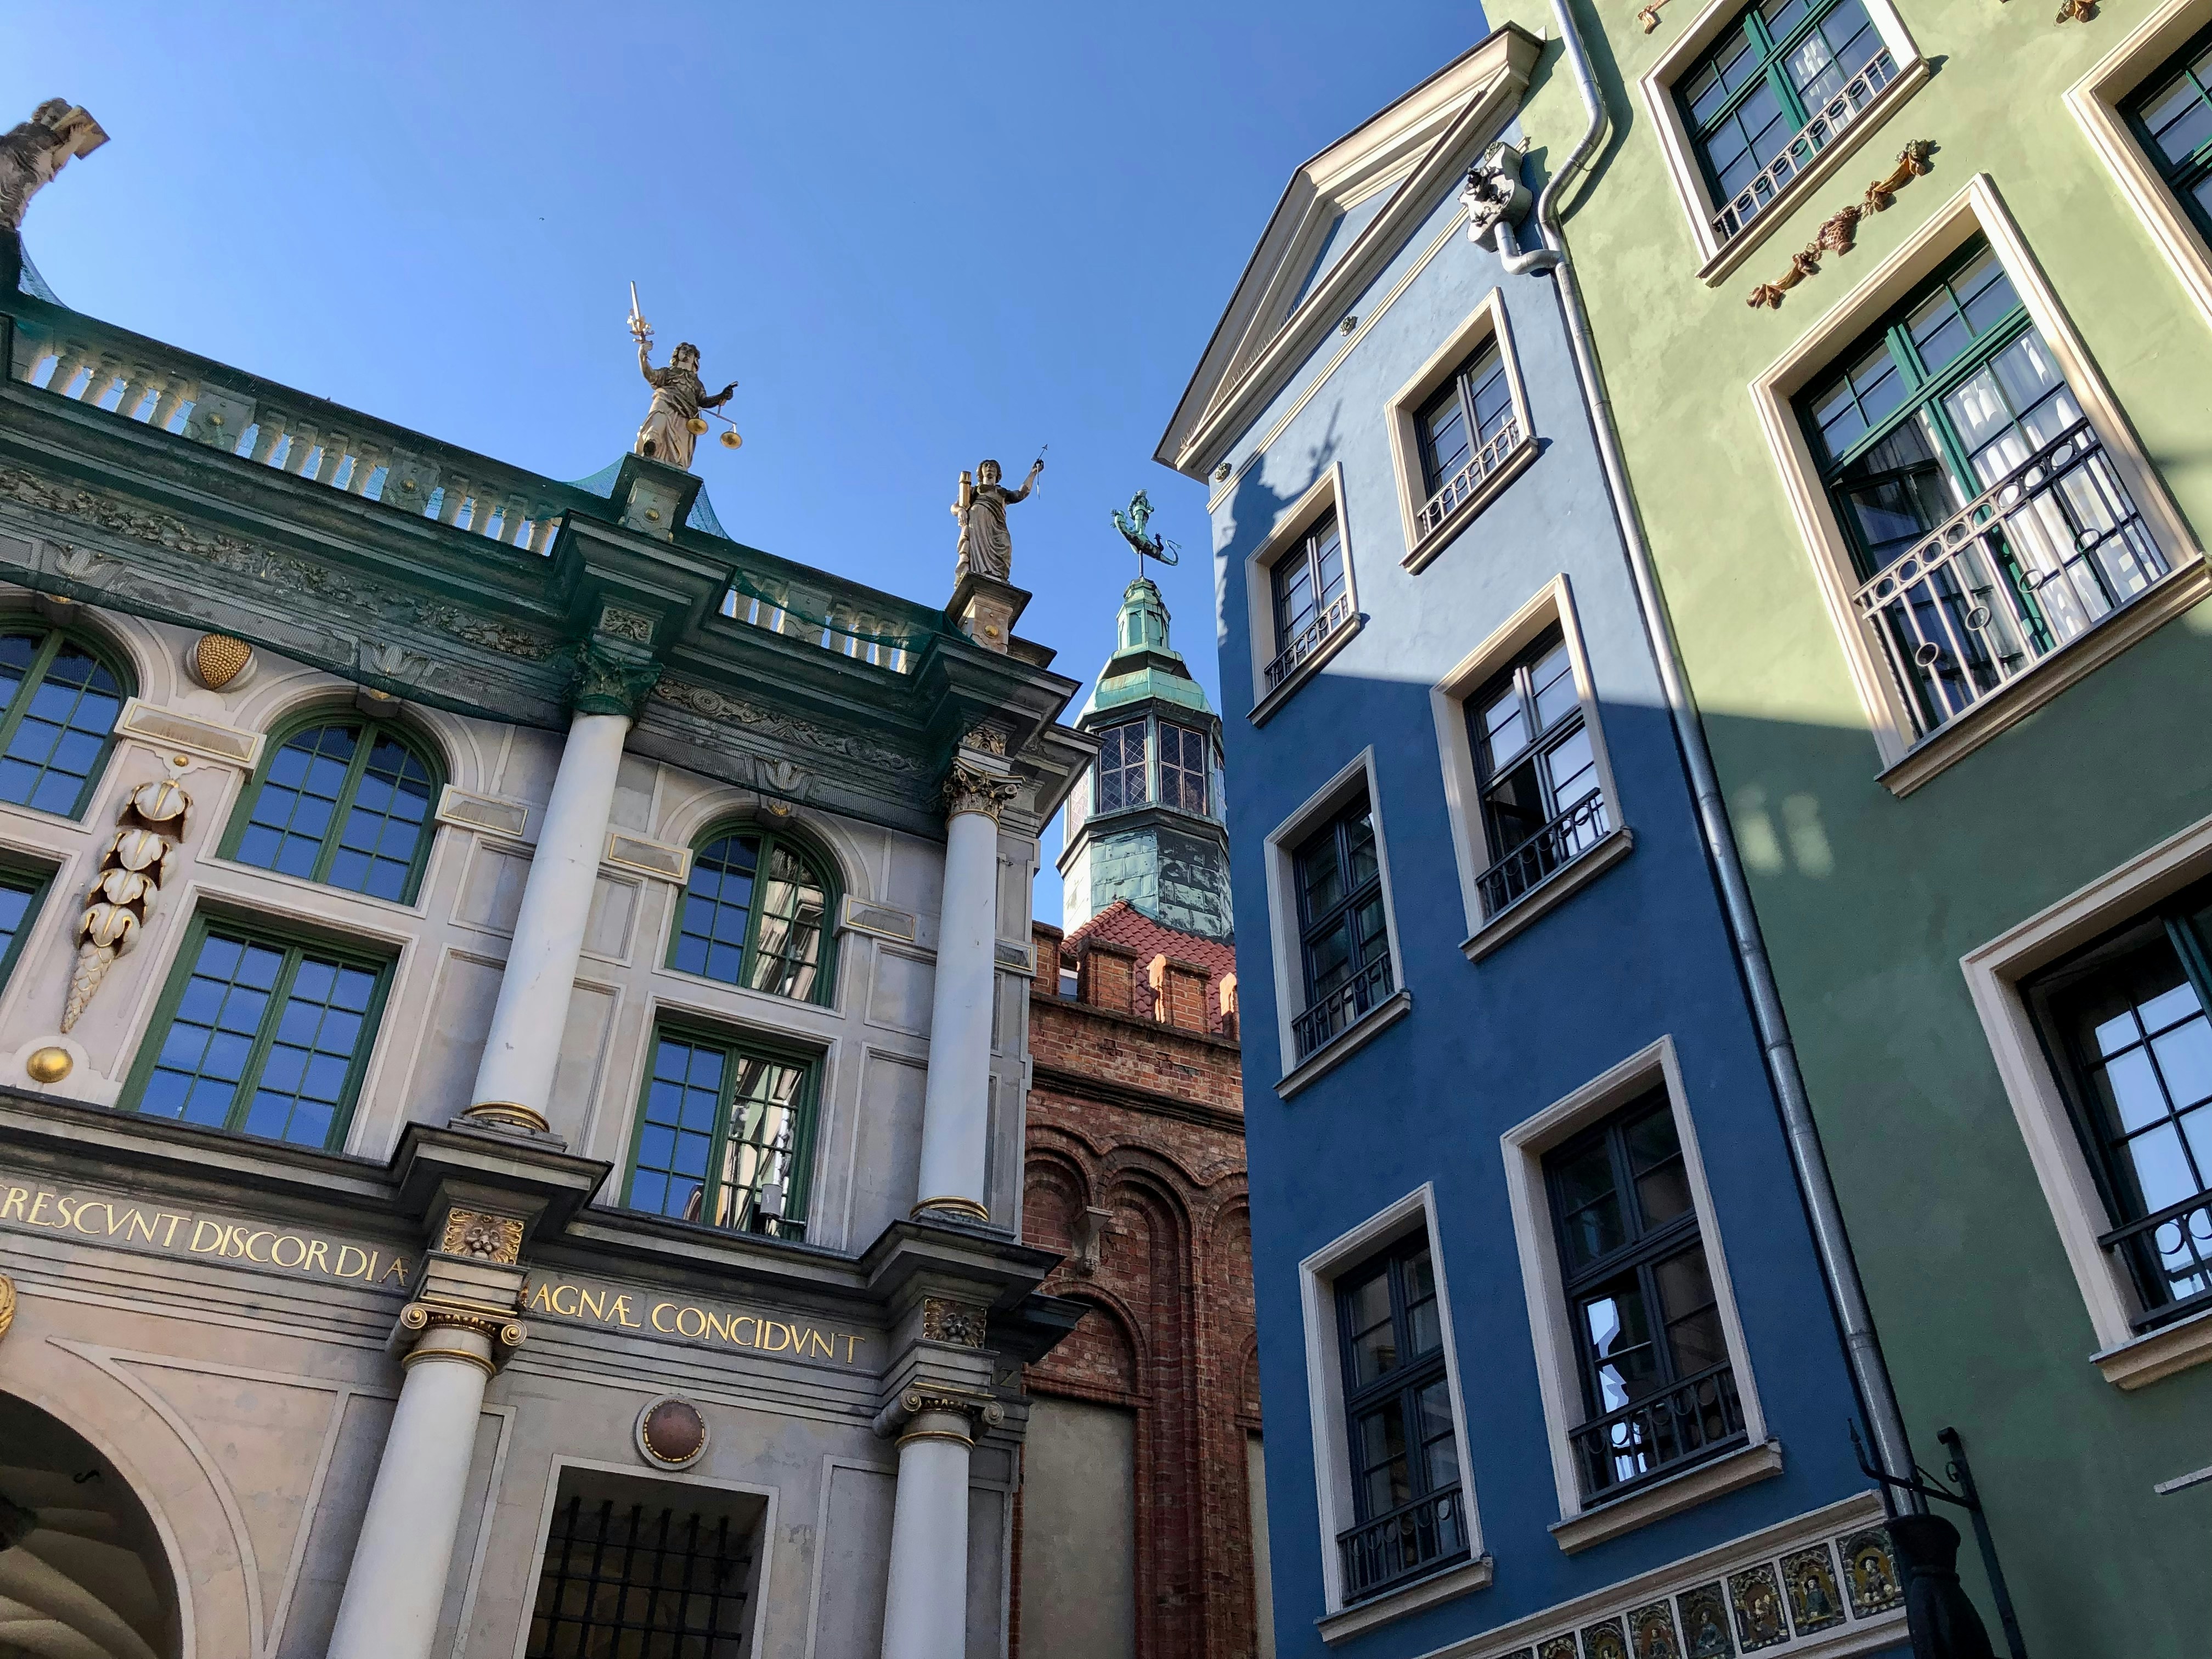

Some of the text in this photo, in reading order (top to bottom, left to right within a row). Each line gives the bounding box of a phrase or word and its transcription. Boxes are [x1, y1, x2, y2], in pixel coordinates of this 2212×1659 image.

[0, 1184, 192, 1248] RESCVNT
[522, 1281, 642, 1328] AGNÆ
[651, 1302, 866, 1364] CONCIDVNT
